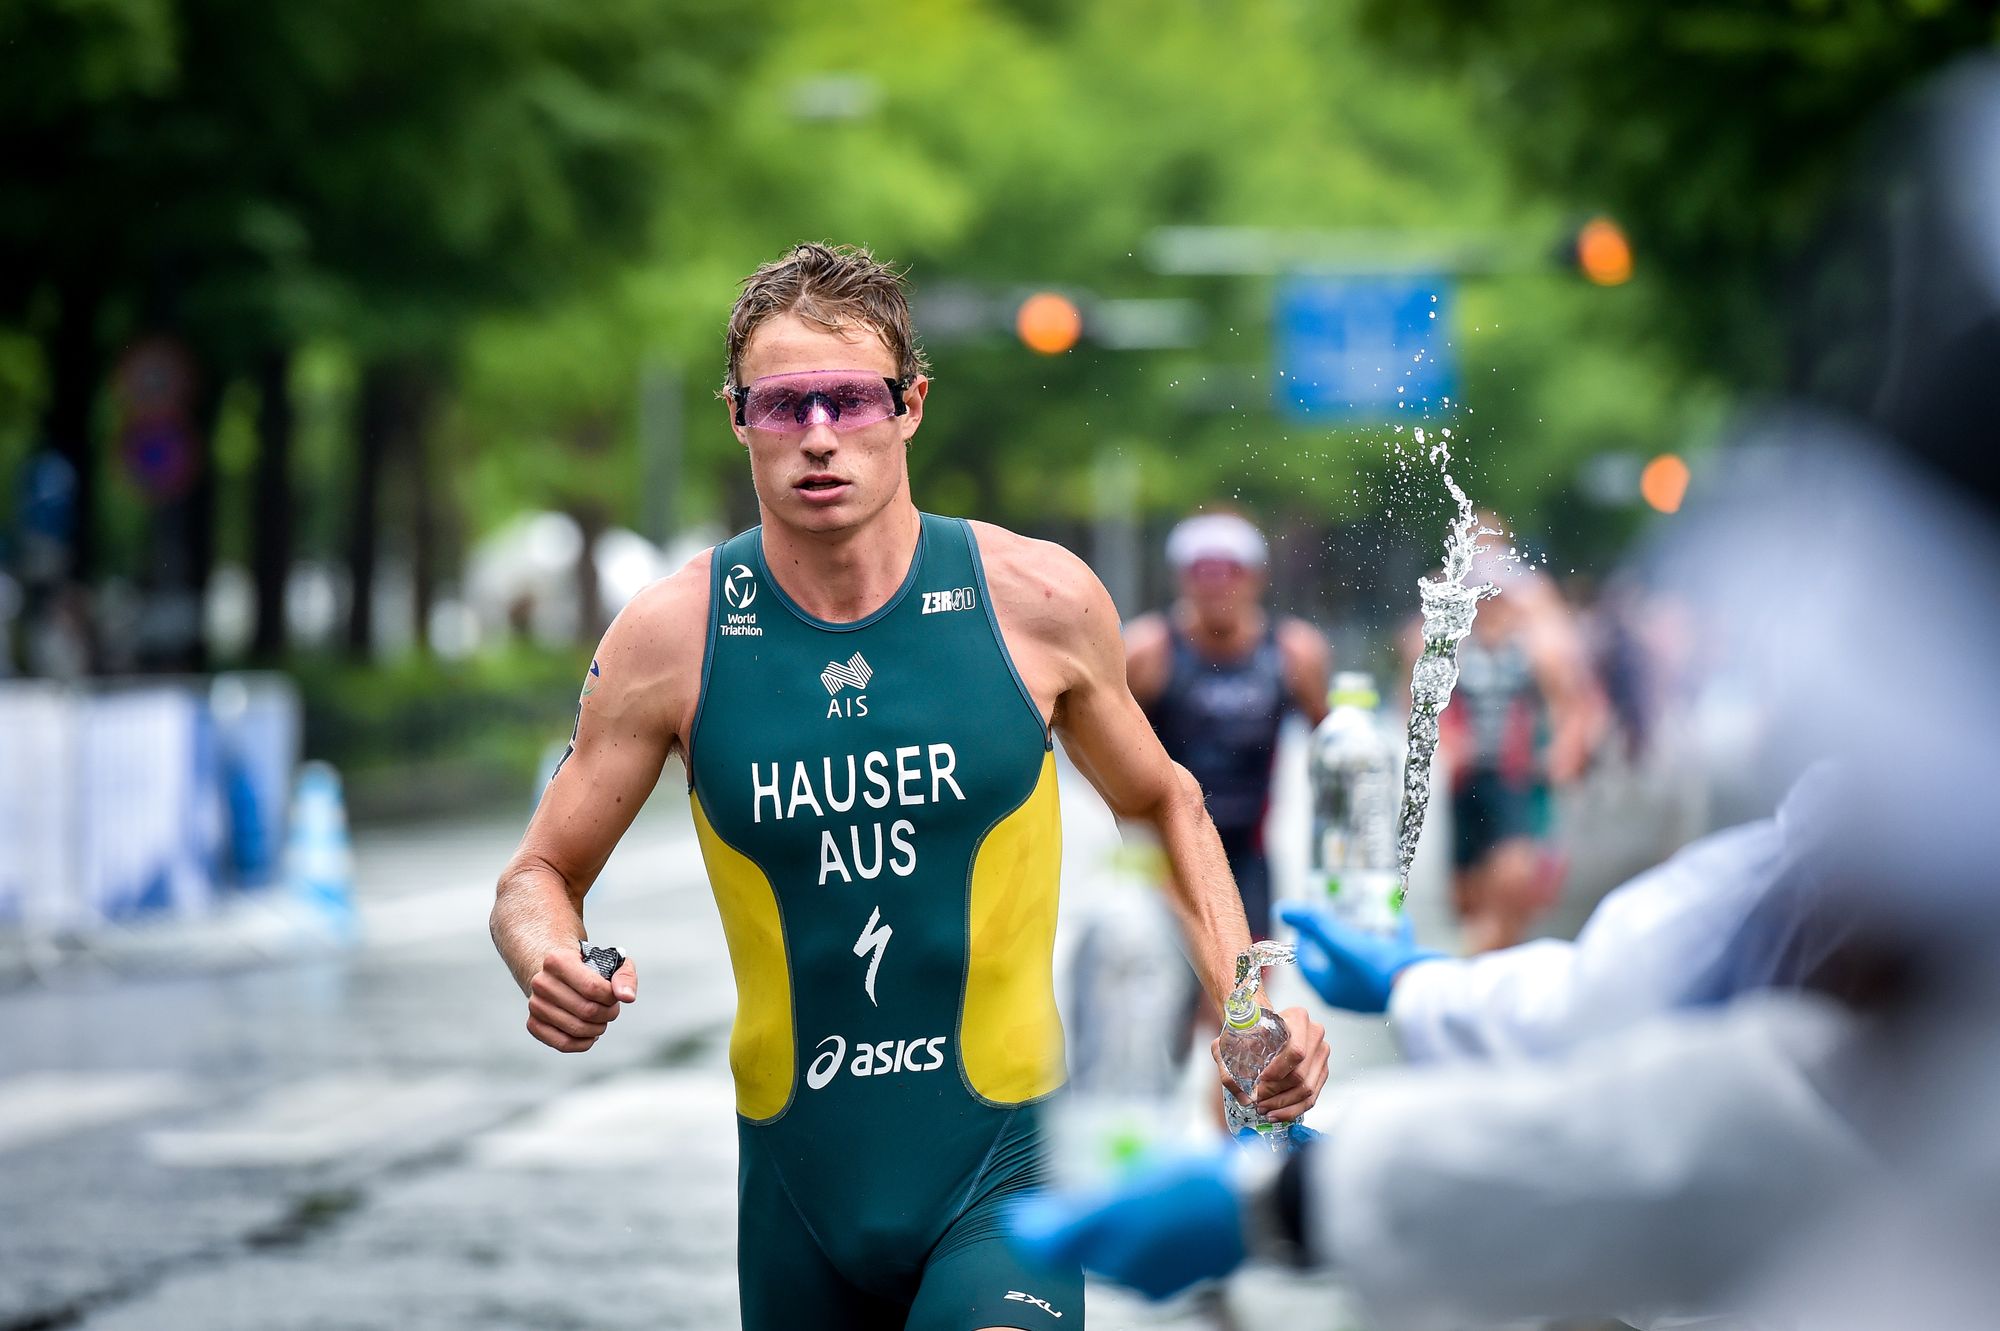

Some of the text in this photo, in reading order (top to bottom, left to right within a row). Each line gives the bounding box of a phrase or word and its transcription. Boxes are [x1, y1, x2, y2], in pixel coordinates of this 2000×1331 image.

[720, 624, 763, 636] Triathlon
[727, 613, 756, 624] World
[827, 696, 868, 719] AIS
[751, 743, 966, 823] HAUSER
[818, 820, 916, 886] AUS
